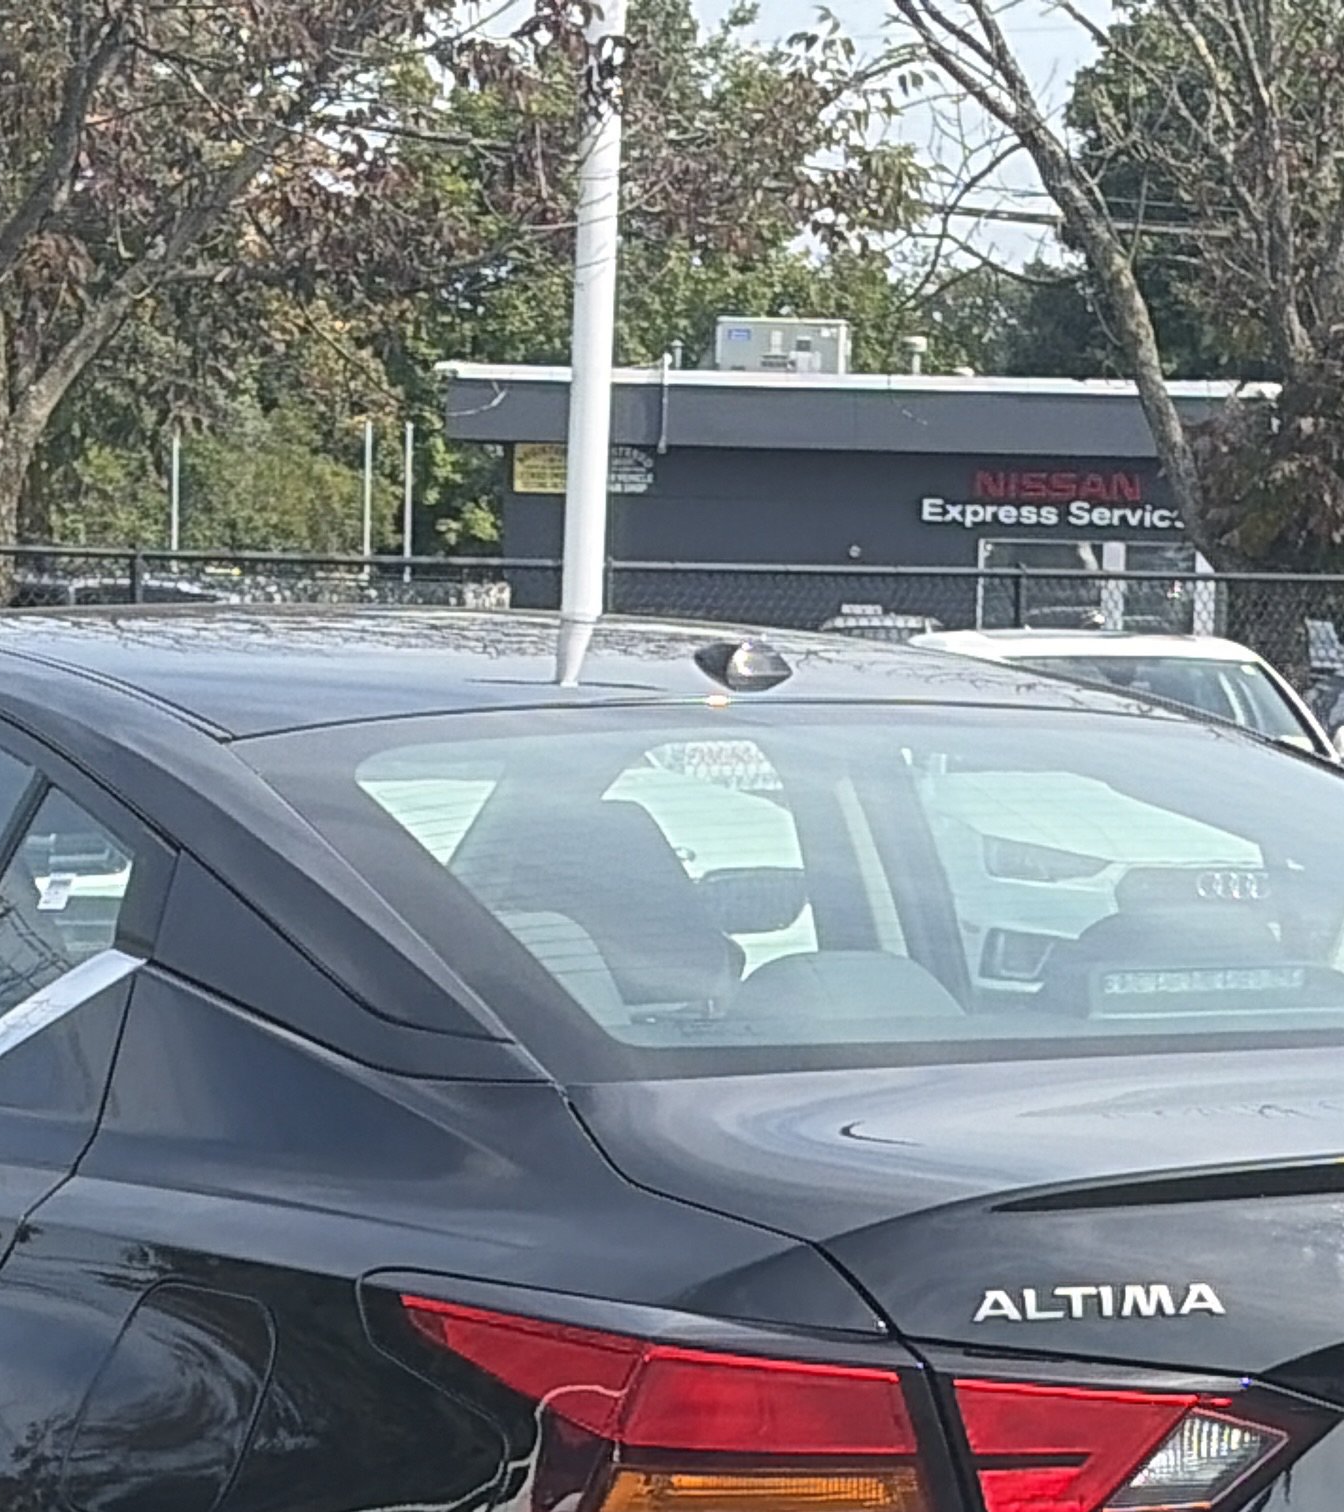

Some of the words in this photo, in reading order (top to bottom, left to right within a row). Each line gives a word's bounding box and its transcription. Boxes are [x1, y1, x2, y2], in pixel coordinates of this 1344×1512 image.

[972, 470, 1142, 500] NISSAN
[921, 498, 1059, 528] Express
[972, 1282, 1227, 1323] ALTIMA
